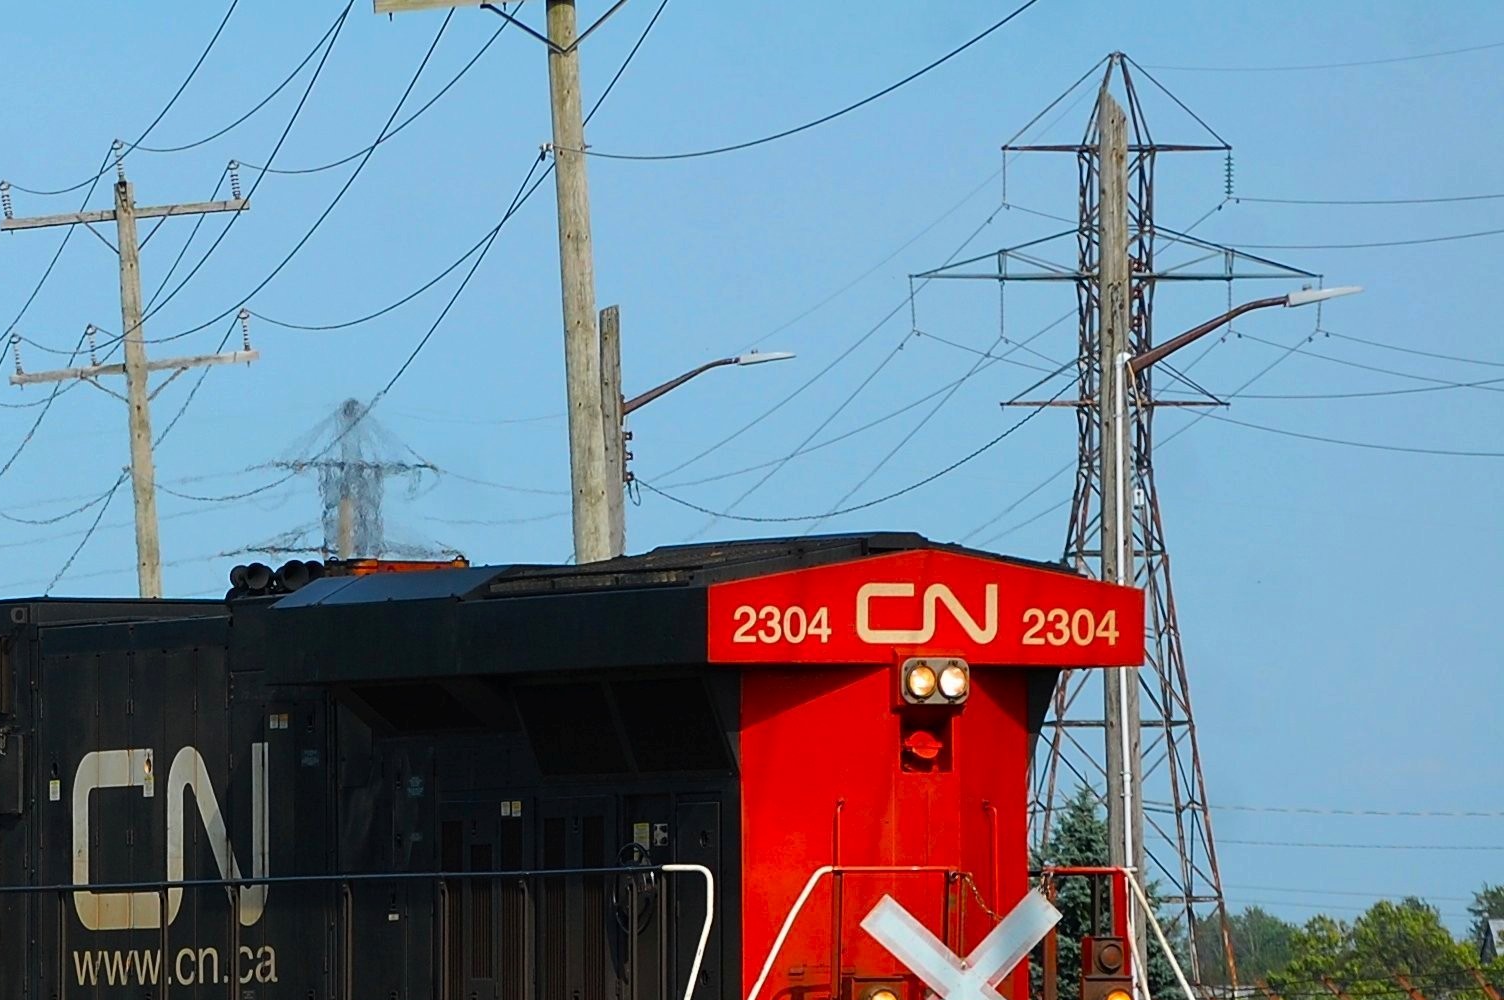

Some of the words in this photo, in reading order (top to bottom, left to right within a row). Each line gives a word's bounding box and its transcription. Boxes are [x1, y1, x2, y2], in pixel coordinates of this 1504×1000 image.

[732, 605, 832, 645] 2304
[856, 582, 998, 645] CN
[1021, 607, 1120, 647] 2304
[72, 741, 270, 931] CN
[73, 944, 278, 986] www.cn.ca
